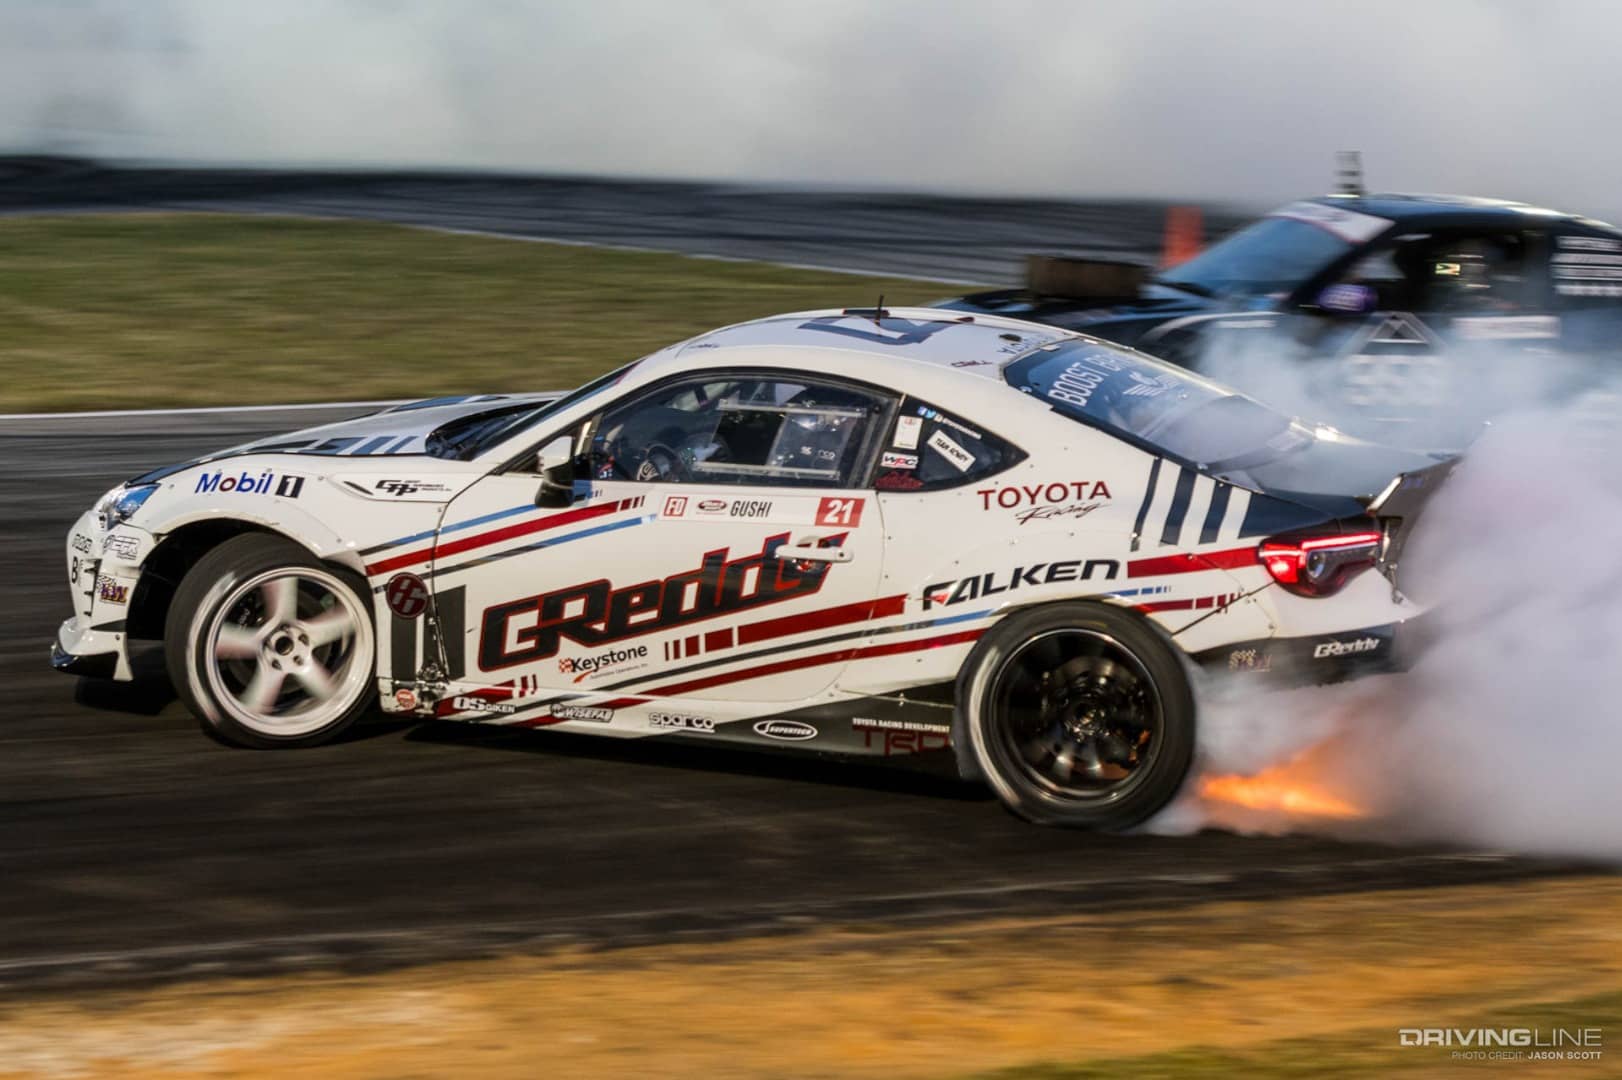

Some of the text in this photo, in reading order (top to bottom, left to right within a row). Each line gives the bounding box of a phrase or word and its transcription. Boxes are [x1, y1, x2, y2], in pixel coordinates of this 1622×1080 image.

[1047, 361, 1109, 407] BOOST
[195, 473, 275, 495] Mobil
[977, 480, 1112, 511] TOYOTA
[730, 501, 773, 517] GUSHI
[822, 499, 851, 524] 21
[1015, 502, 1112, 525] Racing
[922, 559, 1120, 610] FALKEN
[571, 645, 648, 673] Keystone
[649, 712, 715, 730] sparco
